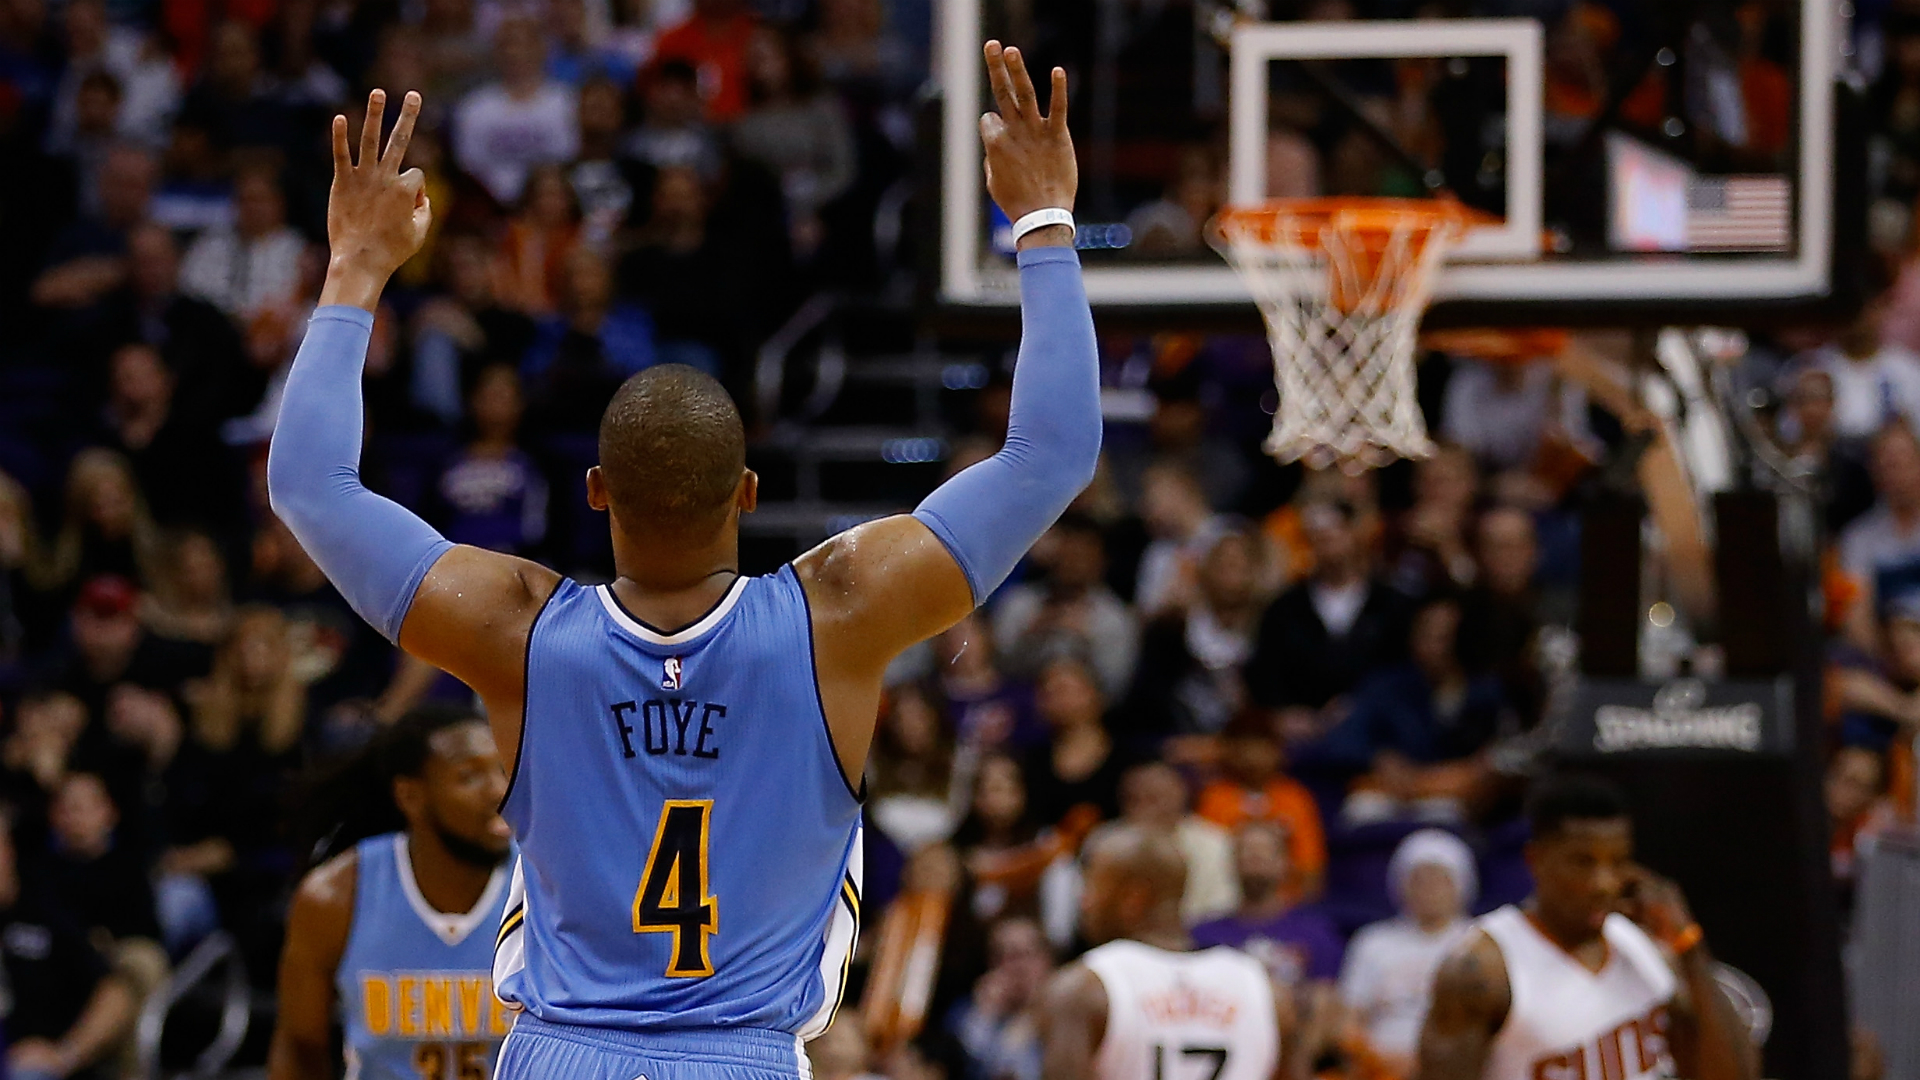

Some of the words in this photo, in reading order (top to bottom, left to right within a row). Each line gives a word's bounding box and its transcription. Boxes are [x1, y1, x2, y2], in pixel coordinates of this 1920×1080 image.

[610, 700, 727, 759] FOYE
[632, 799, 719, 977] 4
[361, 972, 523, 1039] DENVE
[1152, 1043, 1228, 1080] 17
